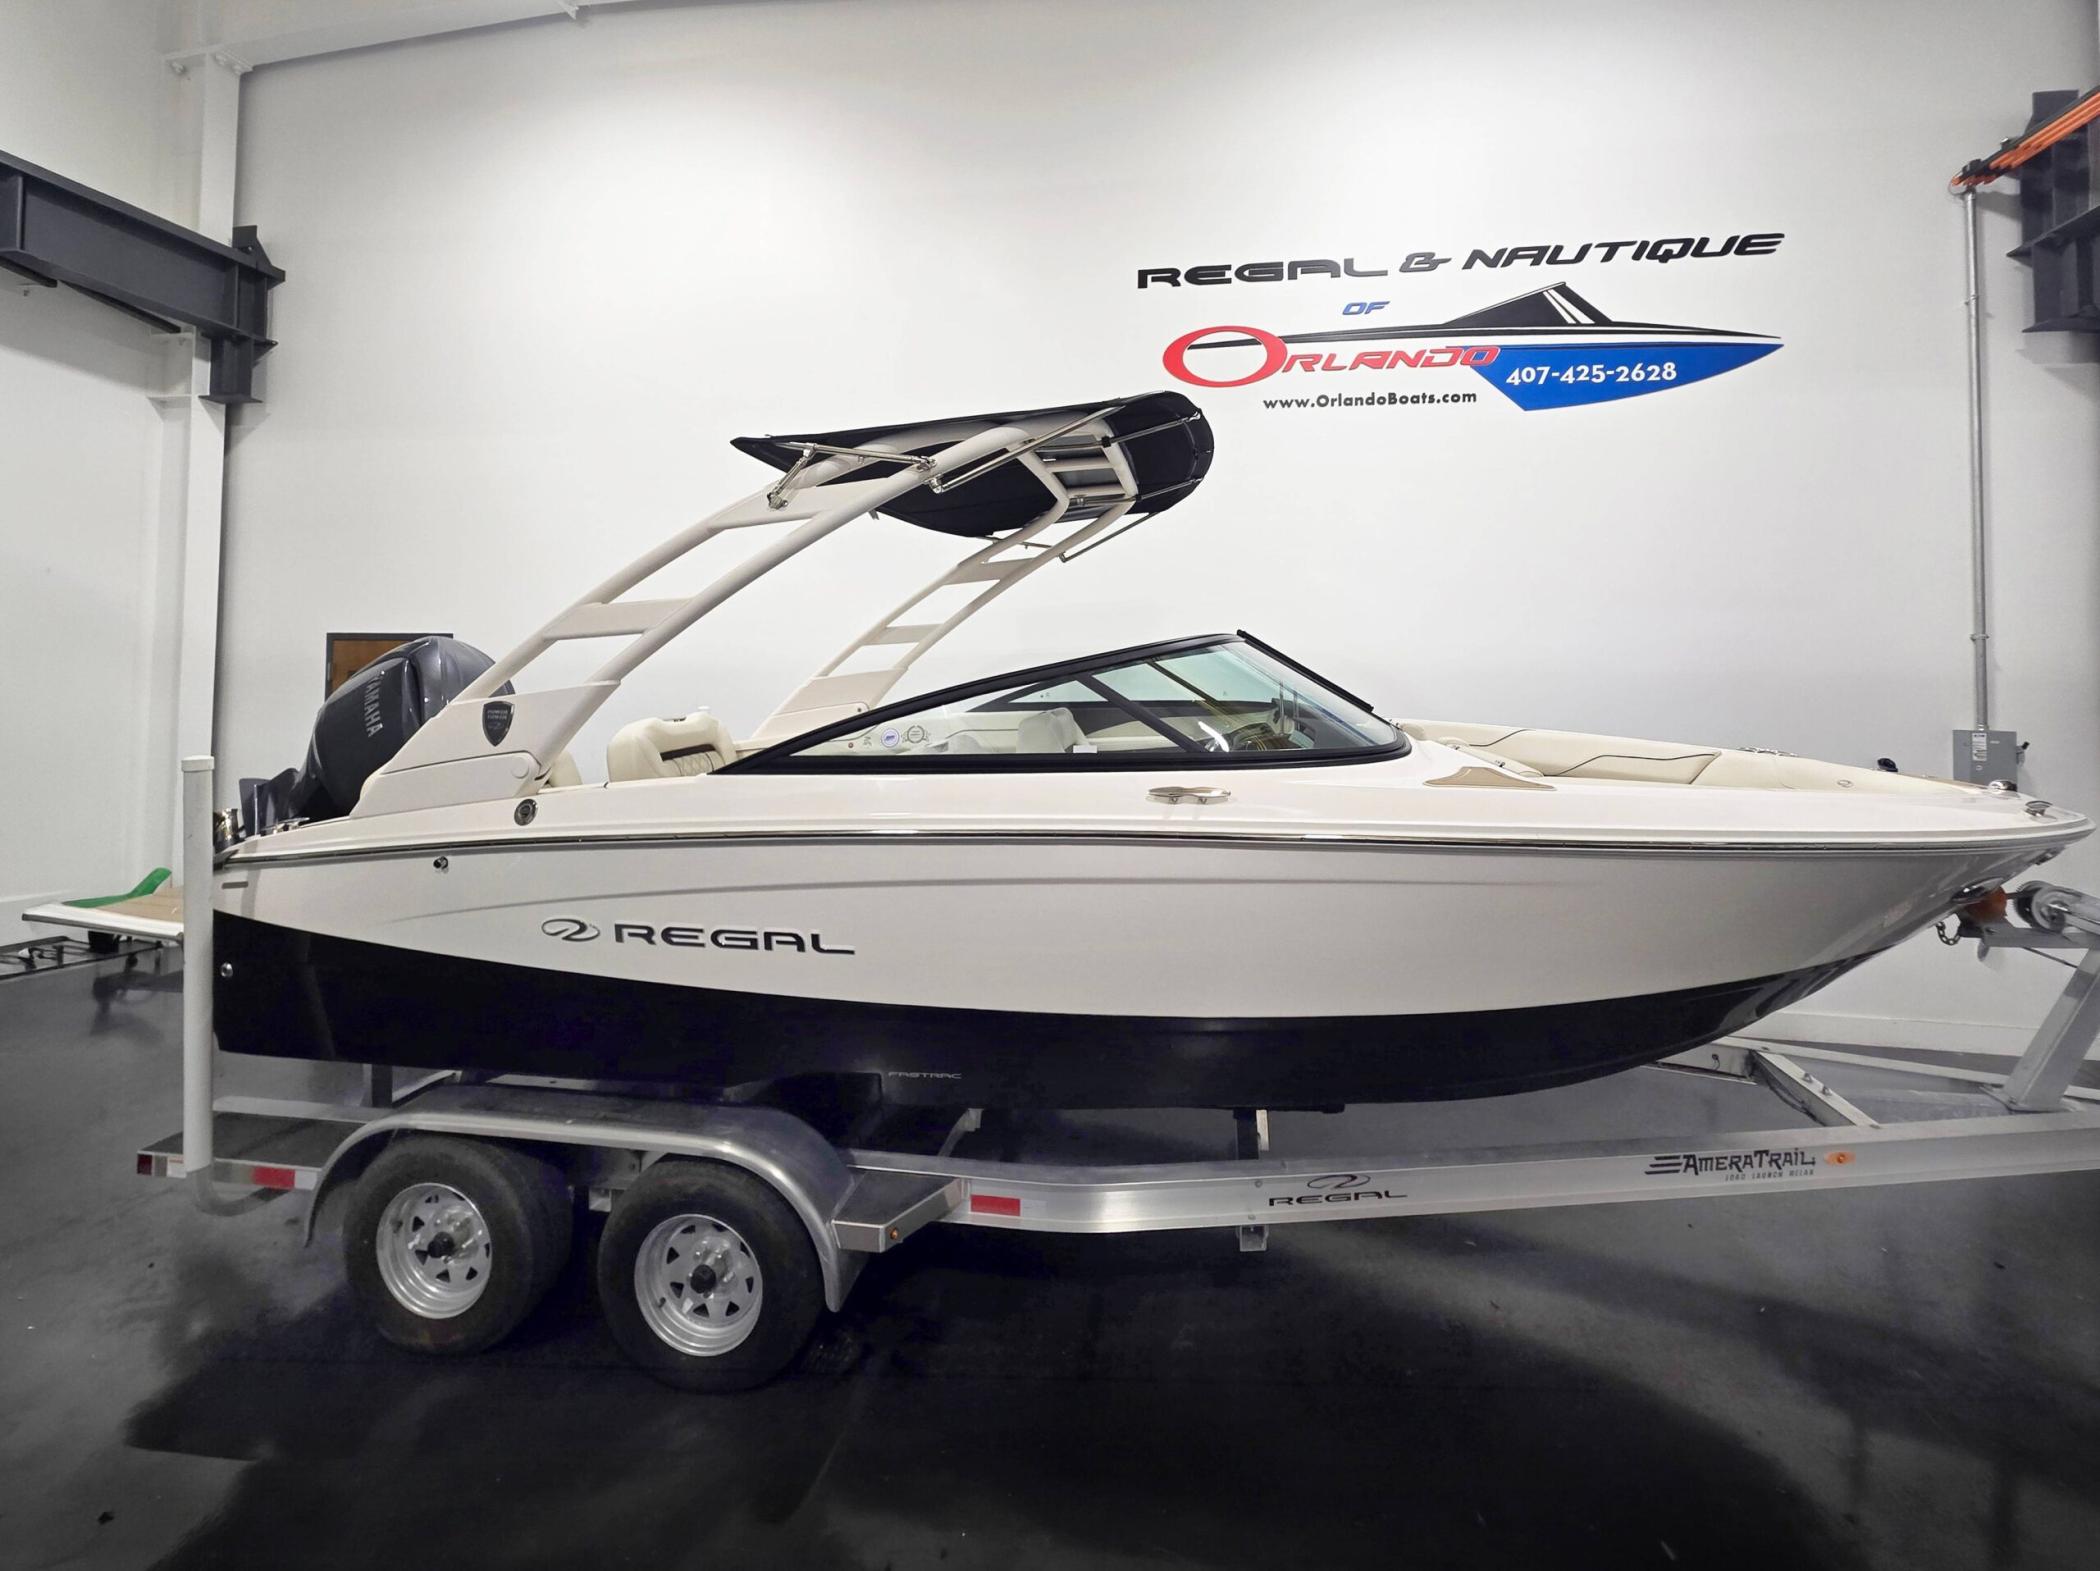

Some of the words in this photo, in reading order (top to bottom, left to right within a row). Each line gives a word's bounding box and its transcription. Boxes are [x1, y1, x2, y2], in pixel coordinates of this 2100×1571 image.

[1137, 258, 1388, 289] REGAL
[1399, 252, 1452, 273] &
[1462, 233, 1785, 270] NAUTIQUE
[1342, 301, 1390, 315] OF
[1162, 325, 1501, 388] ORLANDO
[1506, 363, 1678, 386] 407-425-2628
[1263, 392, 1477, 409] www.OrlandoBoats.com
[364, 674, 383, 737] YAMAHA
[614, 923, 856, 955] REGAL
[1269, 1190, 1408, 1206] REGAL
